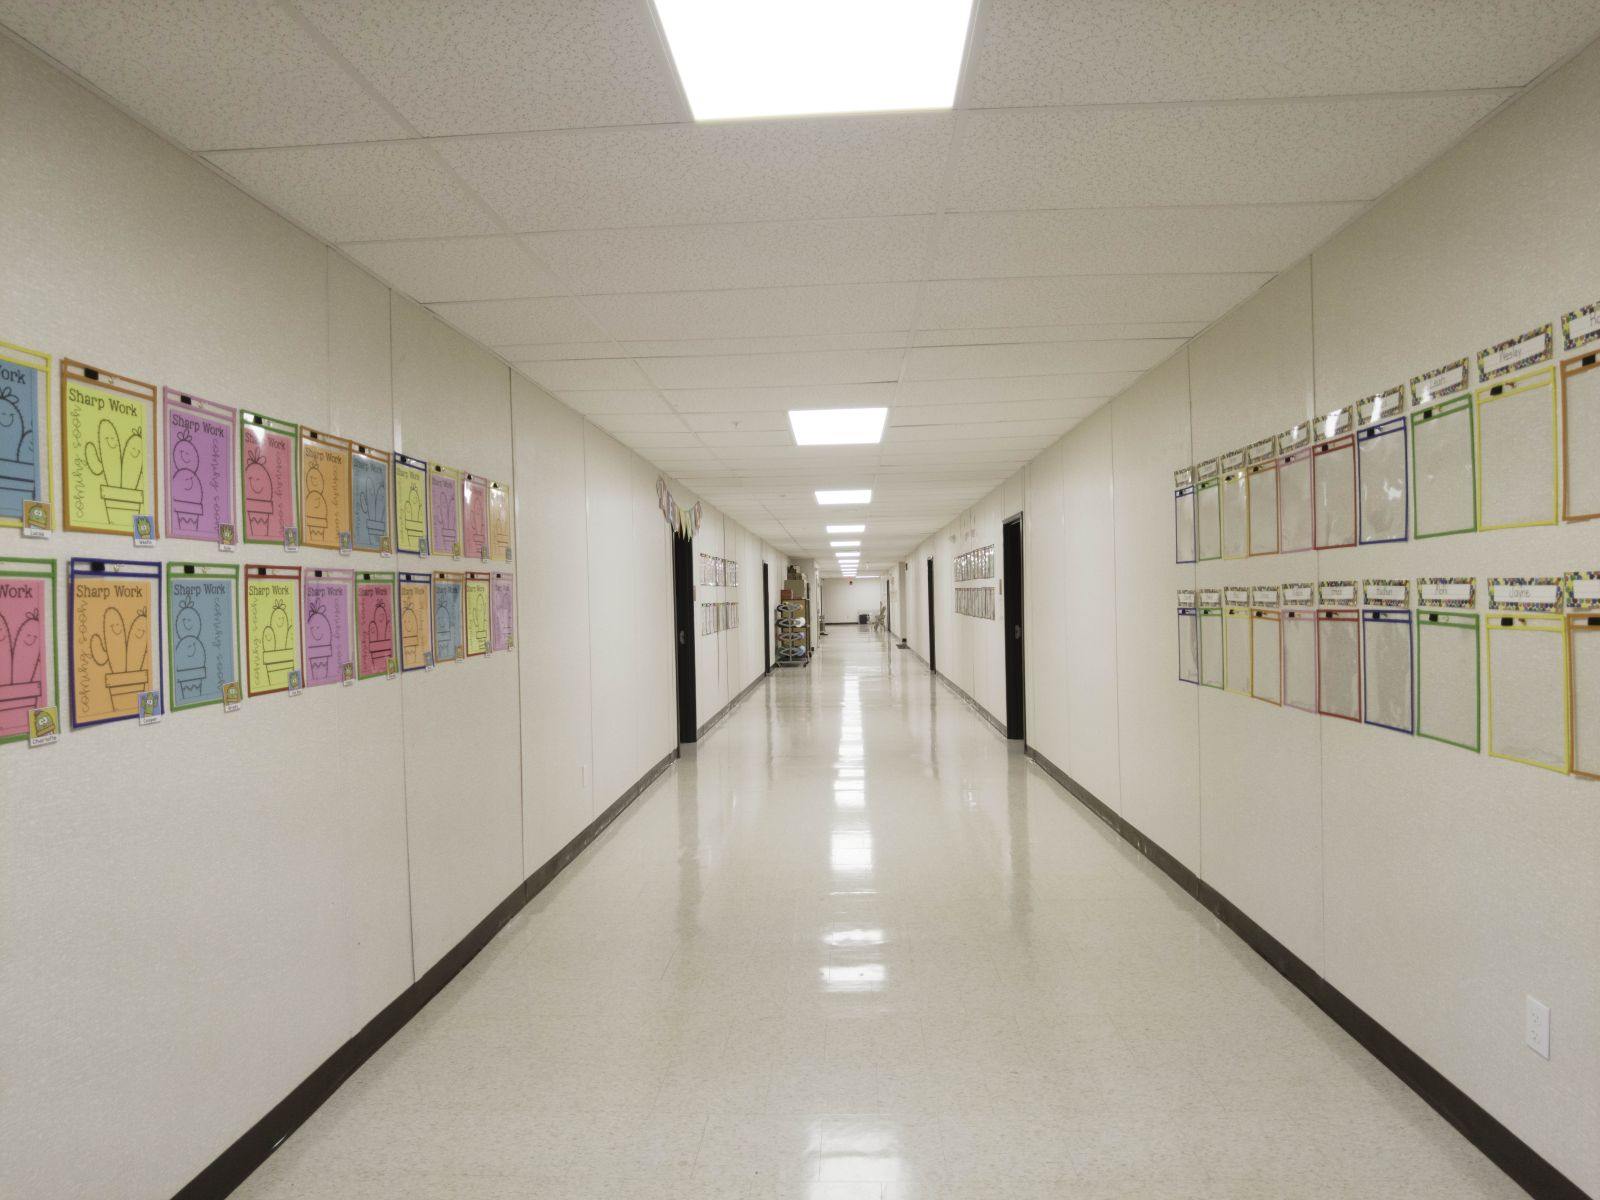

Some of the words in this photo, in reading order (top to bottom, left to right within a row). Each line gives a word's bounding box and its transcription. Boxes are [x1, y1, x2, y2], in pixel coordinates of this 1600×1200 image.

[0, 366, 26, 384] ork
[69, 388, 105, 410] Sharp
[108, 400, 138, 417] Work
[172, 414, 200, 432] Sharp
[203, 424, 225, 438] Work
[76, 585, 111, 600] Sharp
[114, 585, 143, 598] Work
[173, 583, 201, 597] Sharp
[204, 583, 226, 595] Work
[248, 584, 270, 598] Sharp
[271, 585, 289, 597] Work
